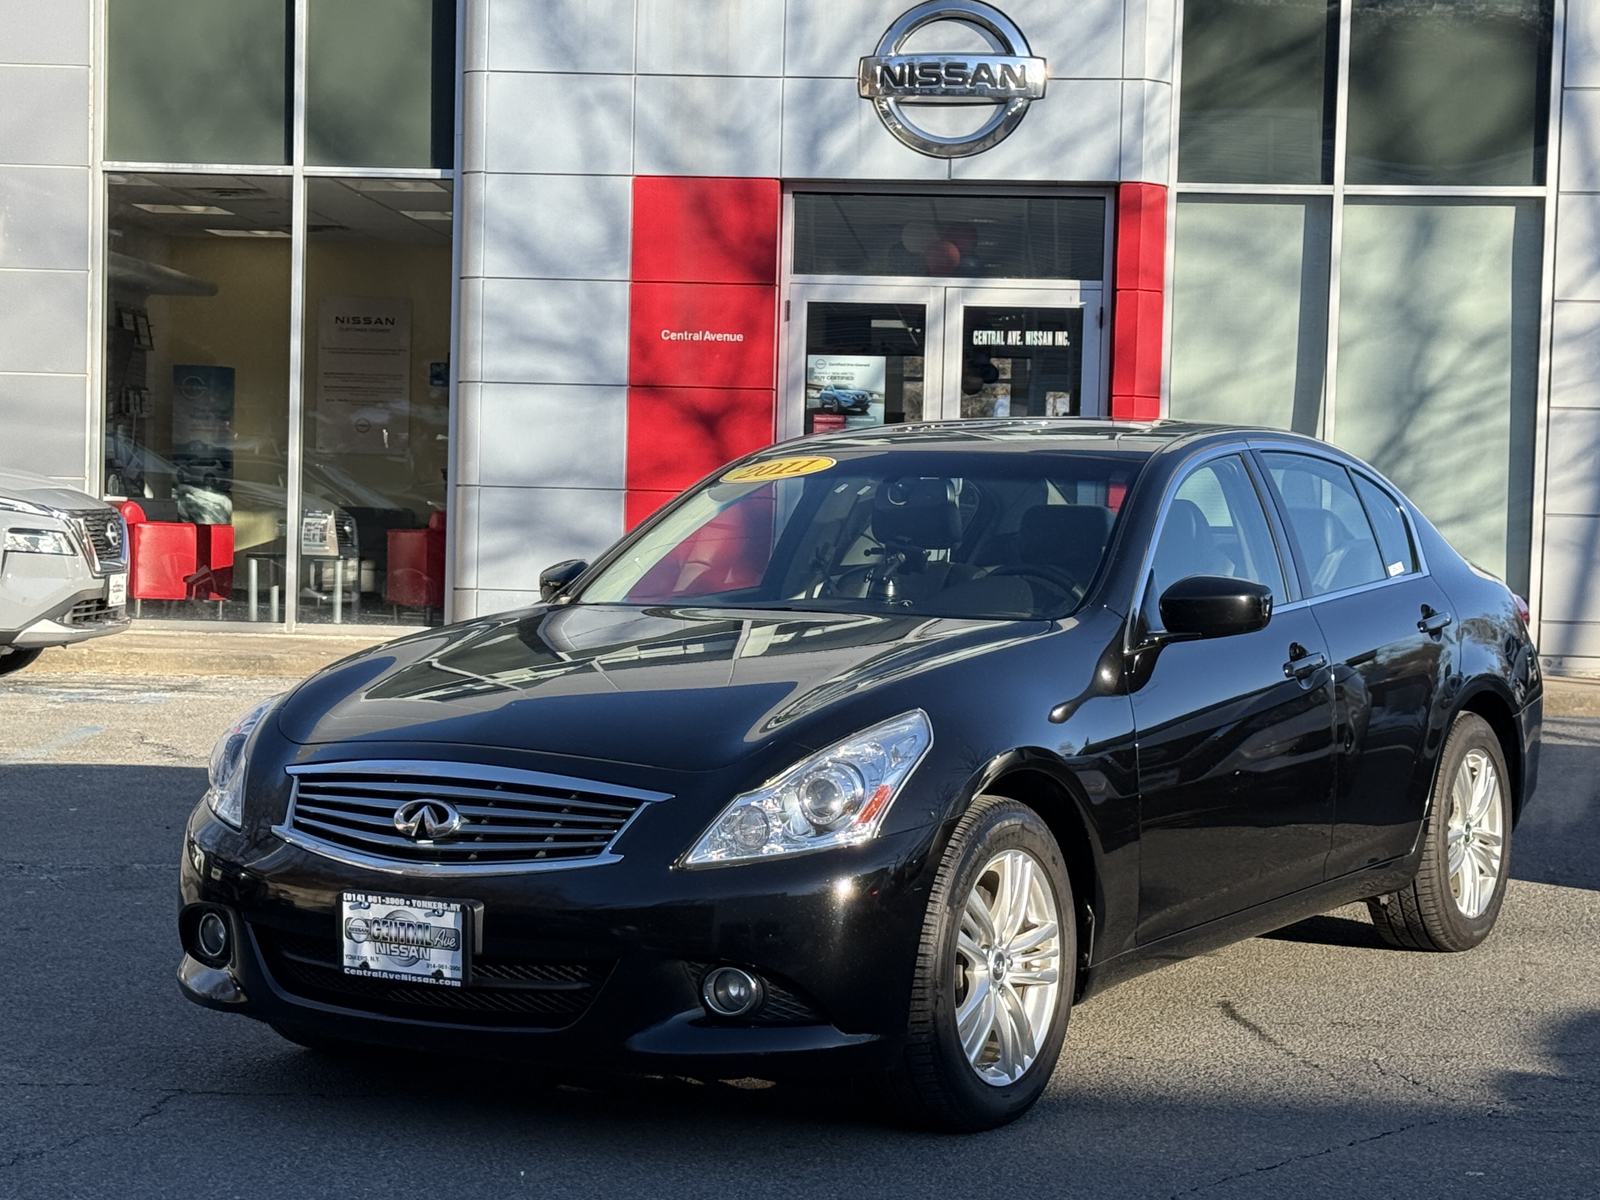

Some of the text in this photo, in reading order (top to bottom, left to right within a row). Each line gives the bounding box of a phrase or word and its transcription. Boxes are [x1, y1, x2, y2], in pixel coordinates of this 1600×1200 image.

[876, 62, 1026, 90] NISSAN
[335, 316, 396, 326] NISSAN
[661, 329, 744, 342] Central Avenue
[973, 330, 1070, 346] CENTRAL AVE. NISSAN INC.
[733, 459, 821, 480] 2011
[371, 917, 433, 947] CENTRAL
[375, 942, 431, 961] NISSAN
[343, 967, 461, 987] CentralAveNissan.com
